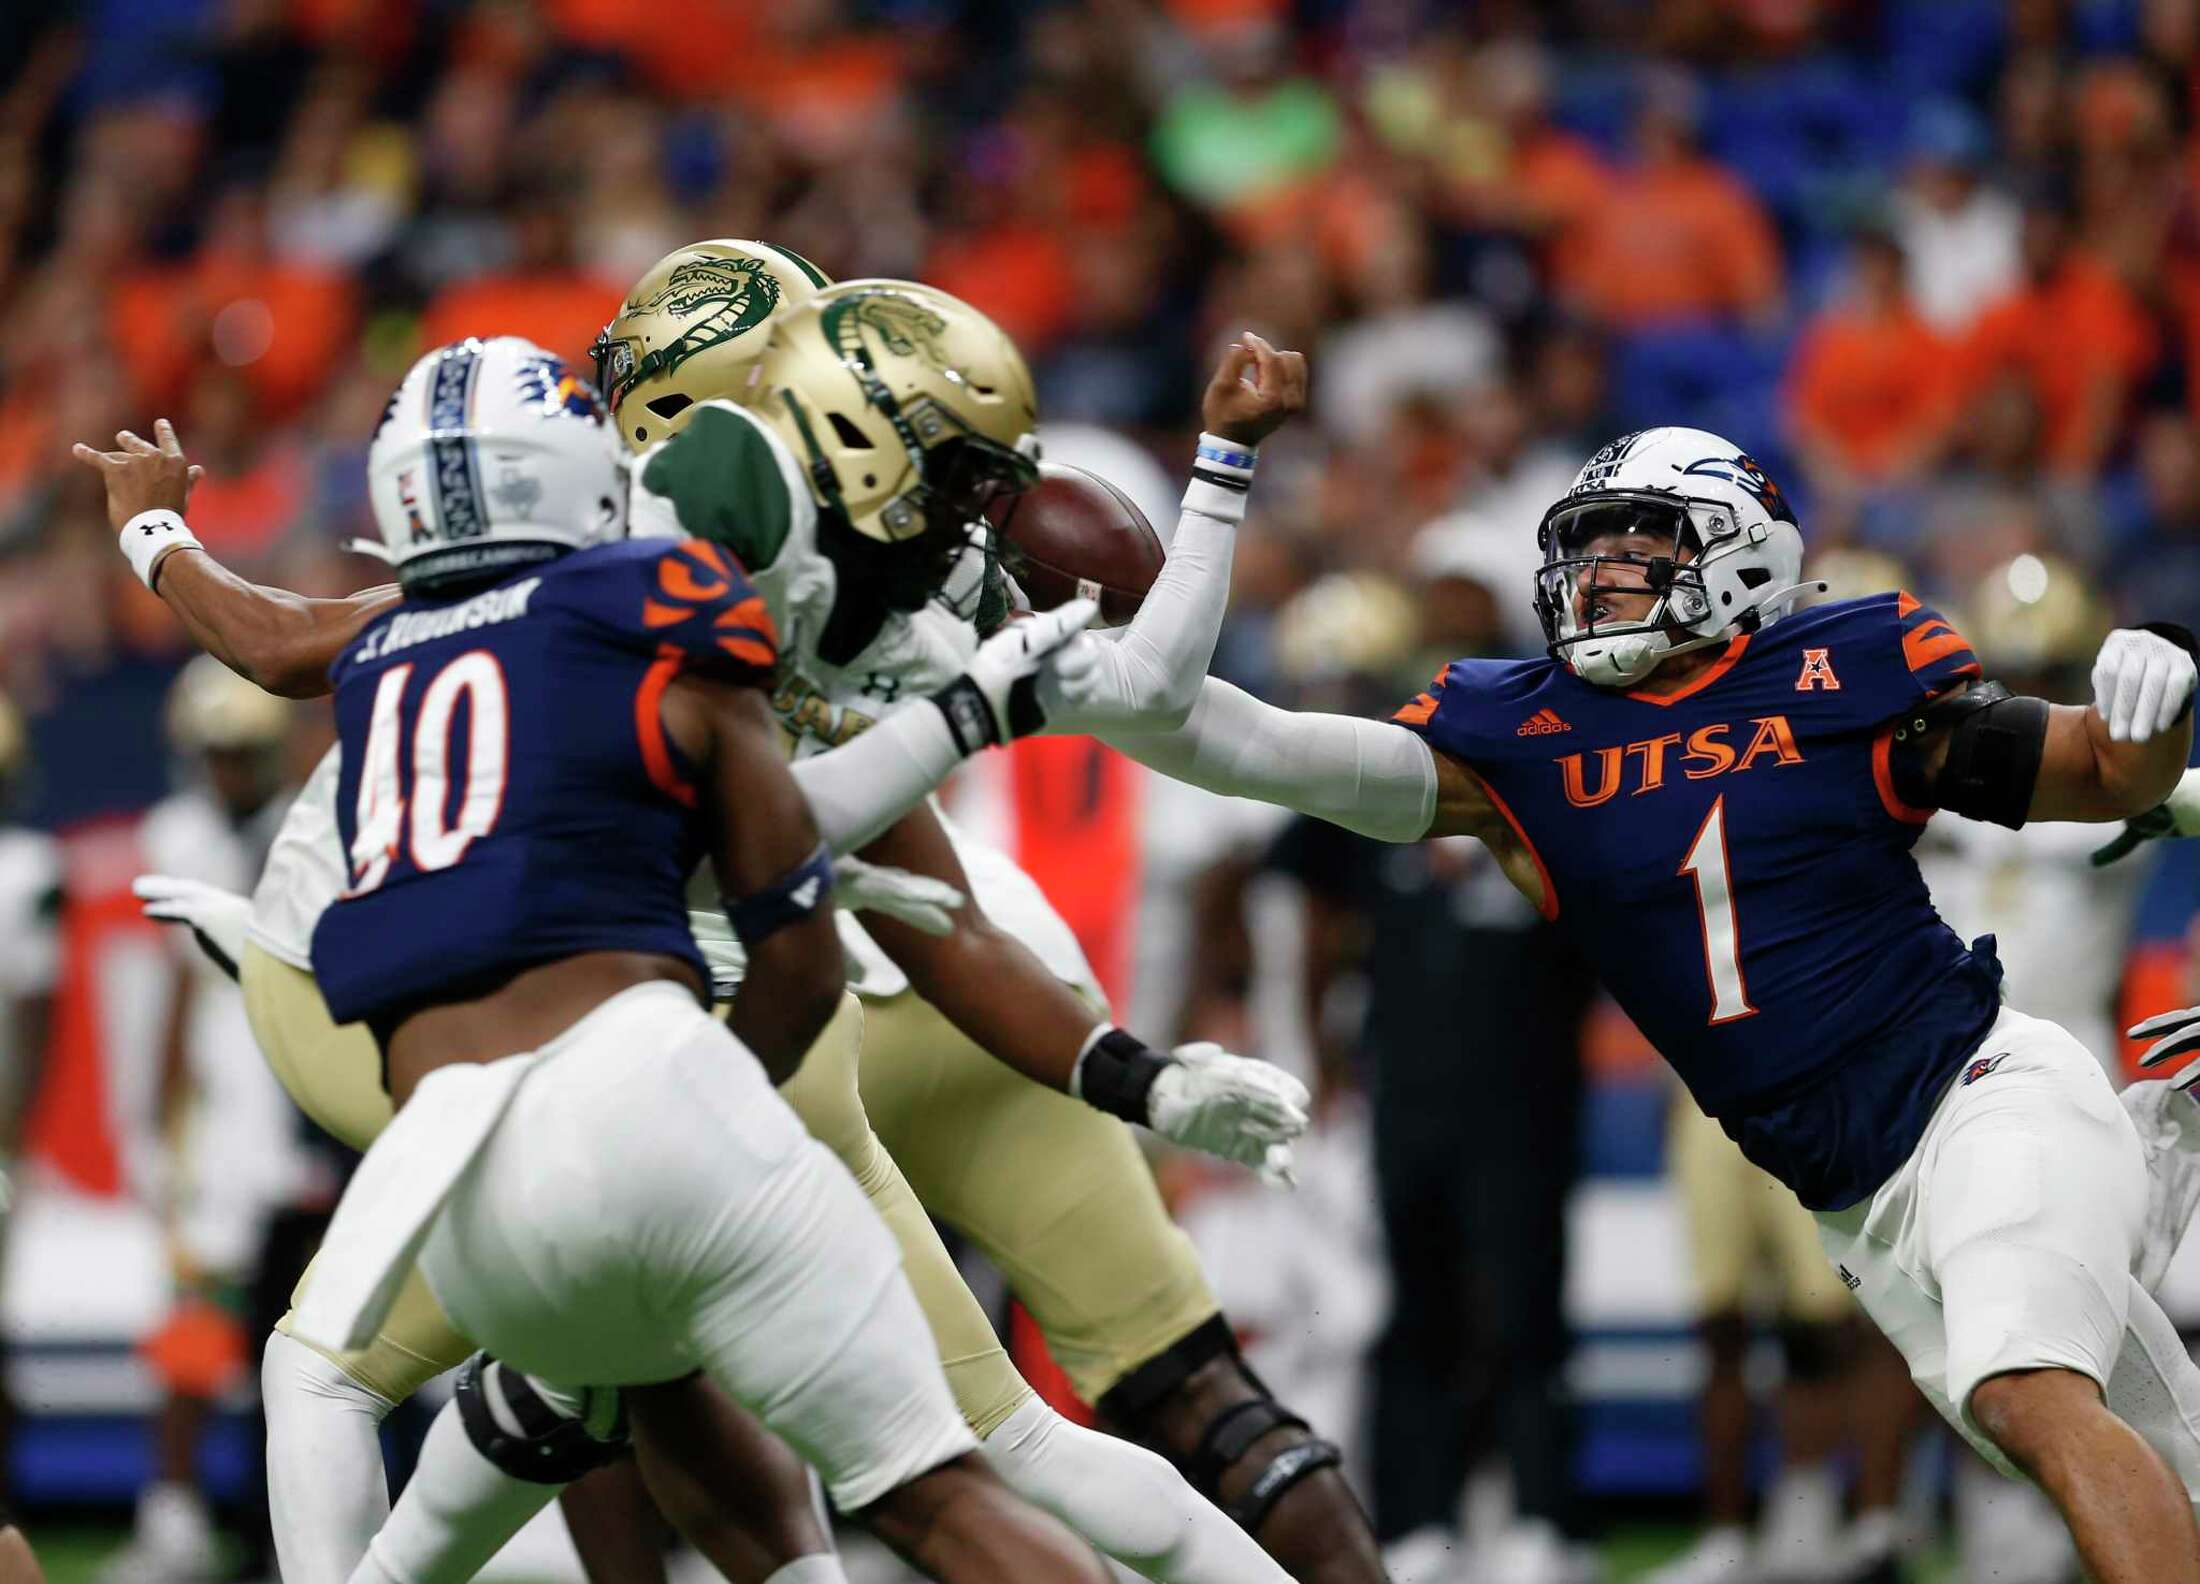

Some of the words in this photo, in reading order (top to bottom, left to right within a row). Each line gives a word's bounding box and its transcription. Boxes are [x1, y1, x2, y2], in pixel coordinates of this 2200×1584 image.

[1795, 648, 1840, 690] A
[340, 649, 510, 901] 40
[1517, 720, 1573, 737] adidas
[1553, 715, 1807, 808] UTSA
[1678, 793, 1760, 1026] 1
